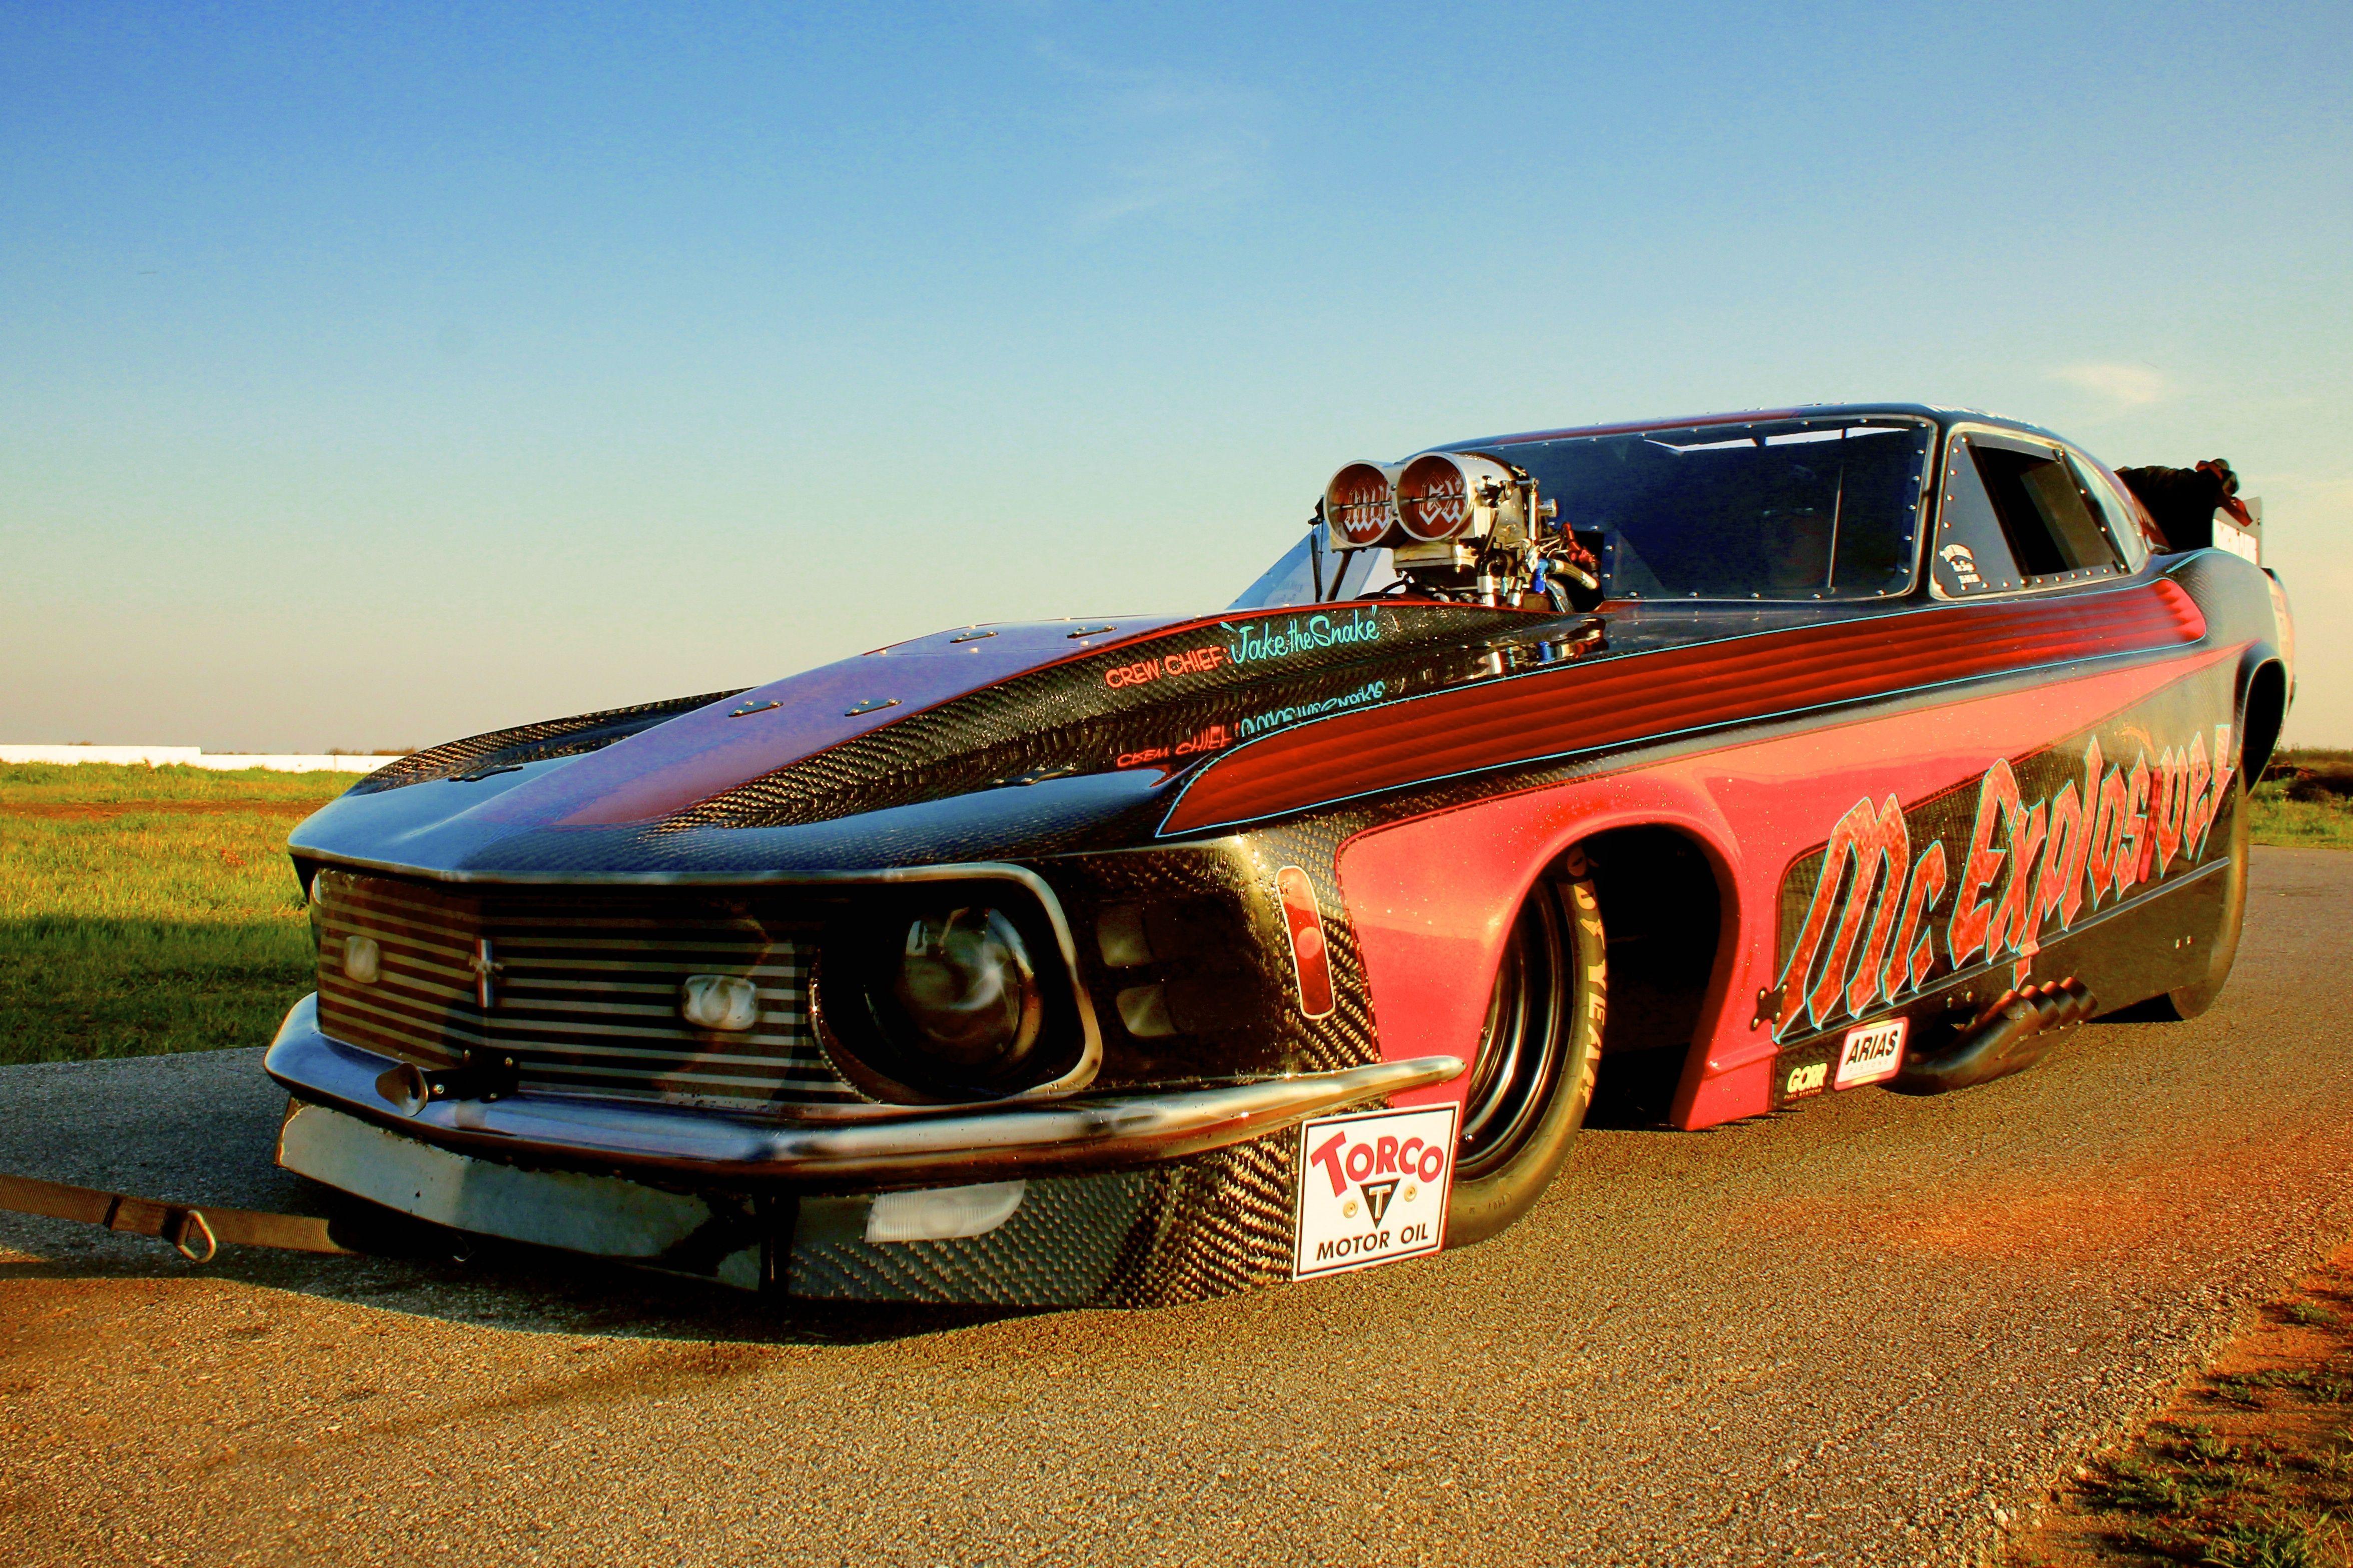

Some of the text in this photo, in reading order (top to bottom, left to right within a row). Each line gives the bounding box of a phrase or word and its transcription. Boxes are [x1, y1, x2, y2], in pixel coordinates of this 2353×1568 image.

[1106, 658, 1161, 688] CREW
[1164, 645, 1234, 675] CHIEF:
[1287, 619, 1314, 652] the
[1845, 1029, 1898, 1065] ARIAS
[1310, 1131, 1444, 1198] TORCO
[1368, 1185, 1391, 1219] T
[1316, 1223, 1428, 1261] MOTOR OIL
